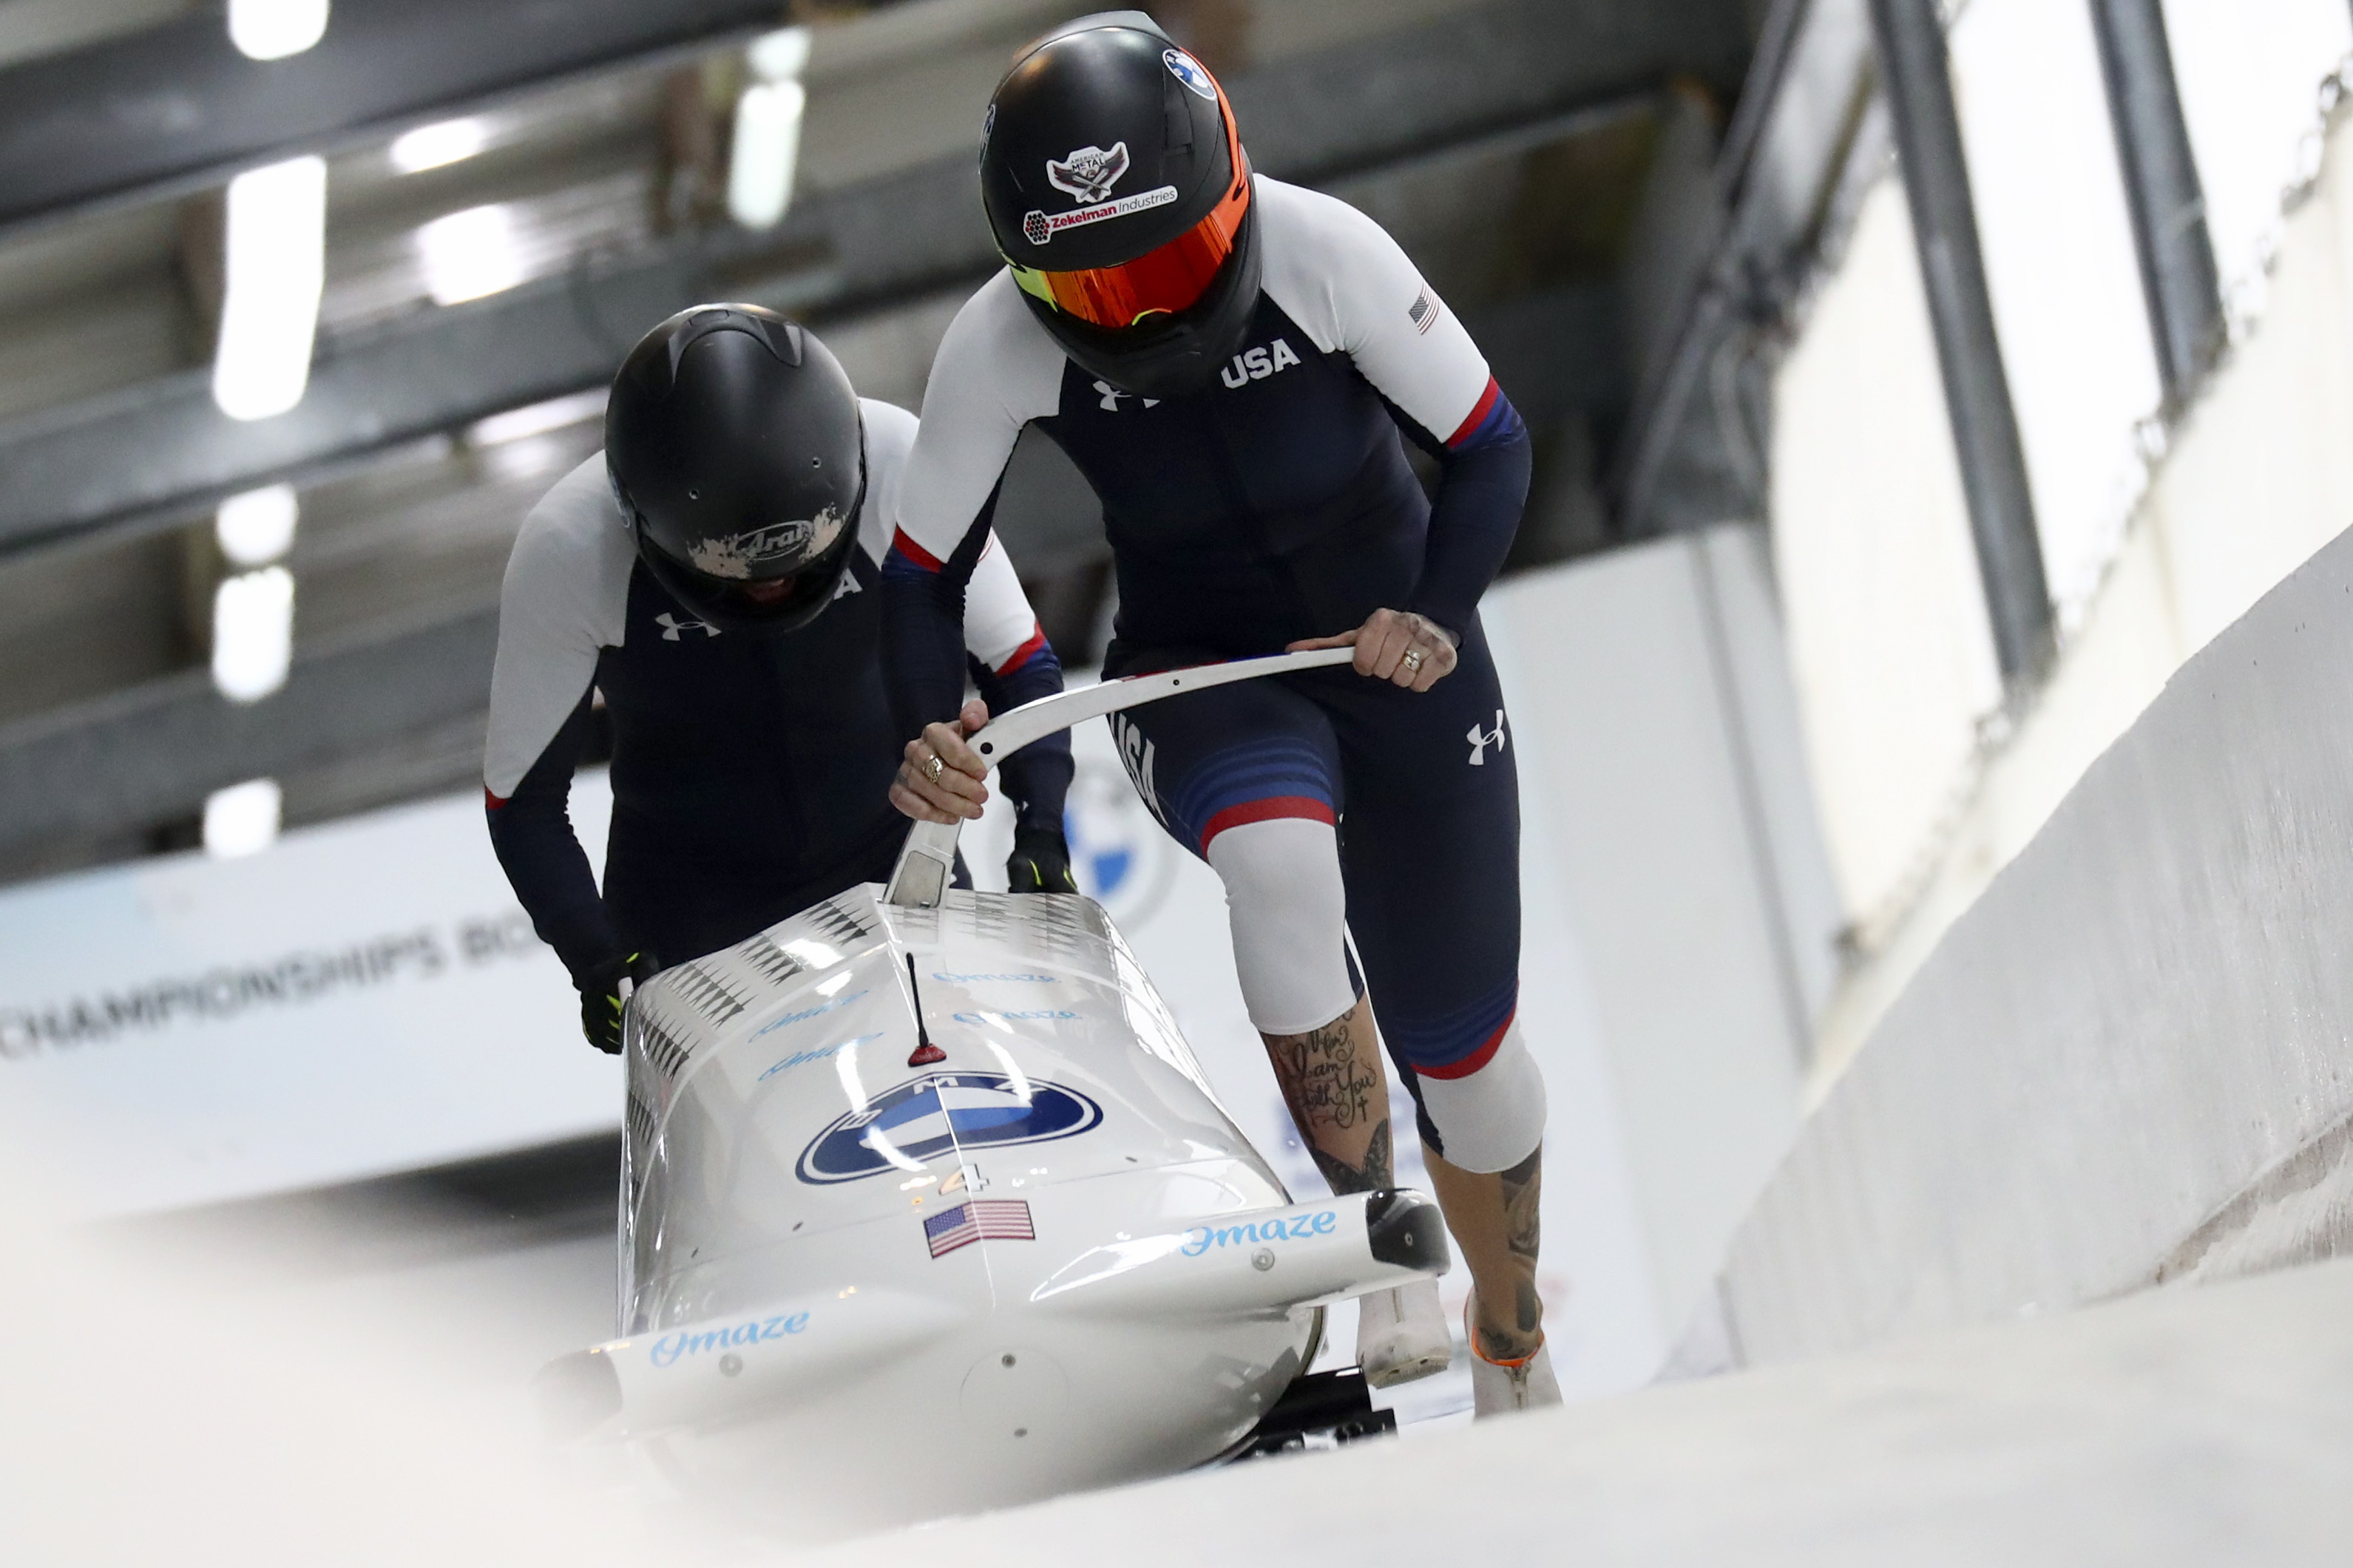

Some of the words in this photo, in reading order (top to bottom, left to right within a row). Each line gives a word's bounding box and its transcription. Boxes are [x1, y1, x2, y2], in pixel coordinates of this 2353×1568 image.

[1071, 157, 1106, 172] METAL
[1051, 205, 1117, 229] Zekelman
[1118, 189, 1176, 214] Industries
[1220, 338, 1301, 390] USA
[0, 922, 447, 1060] CHAMPIONSHIPS
[1180, 1210, 1336, 1258] Omaze
[650, 1309, 810, 1369] Omaze
